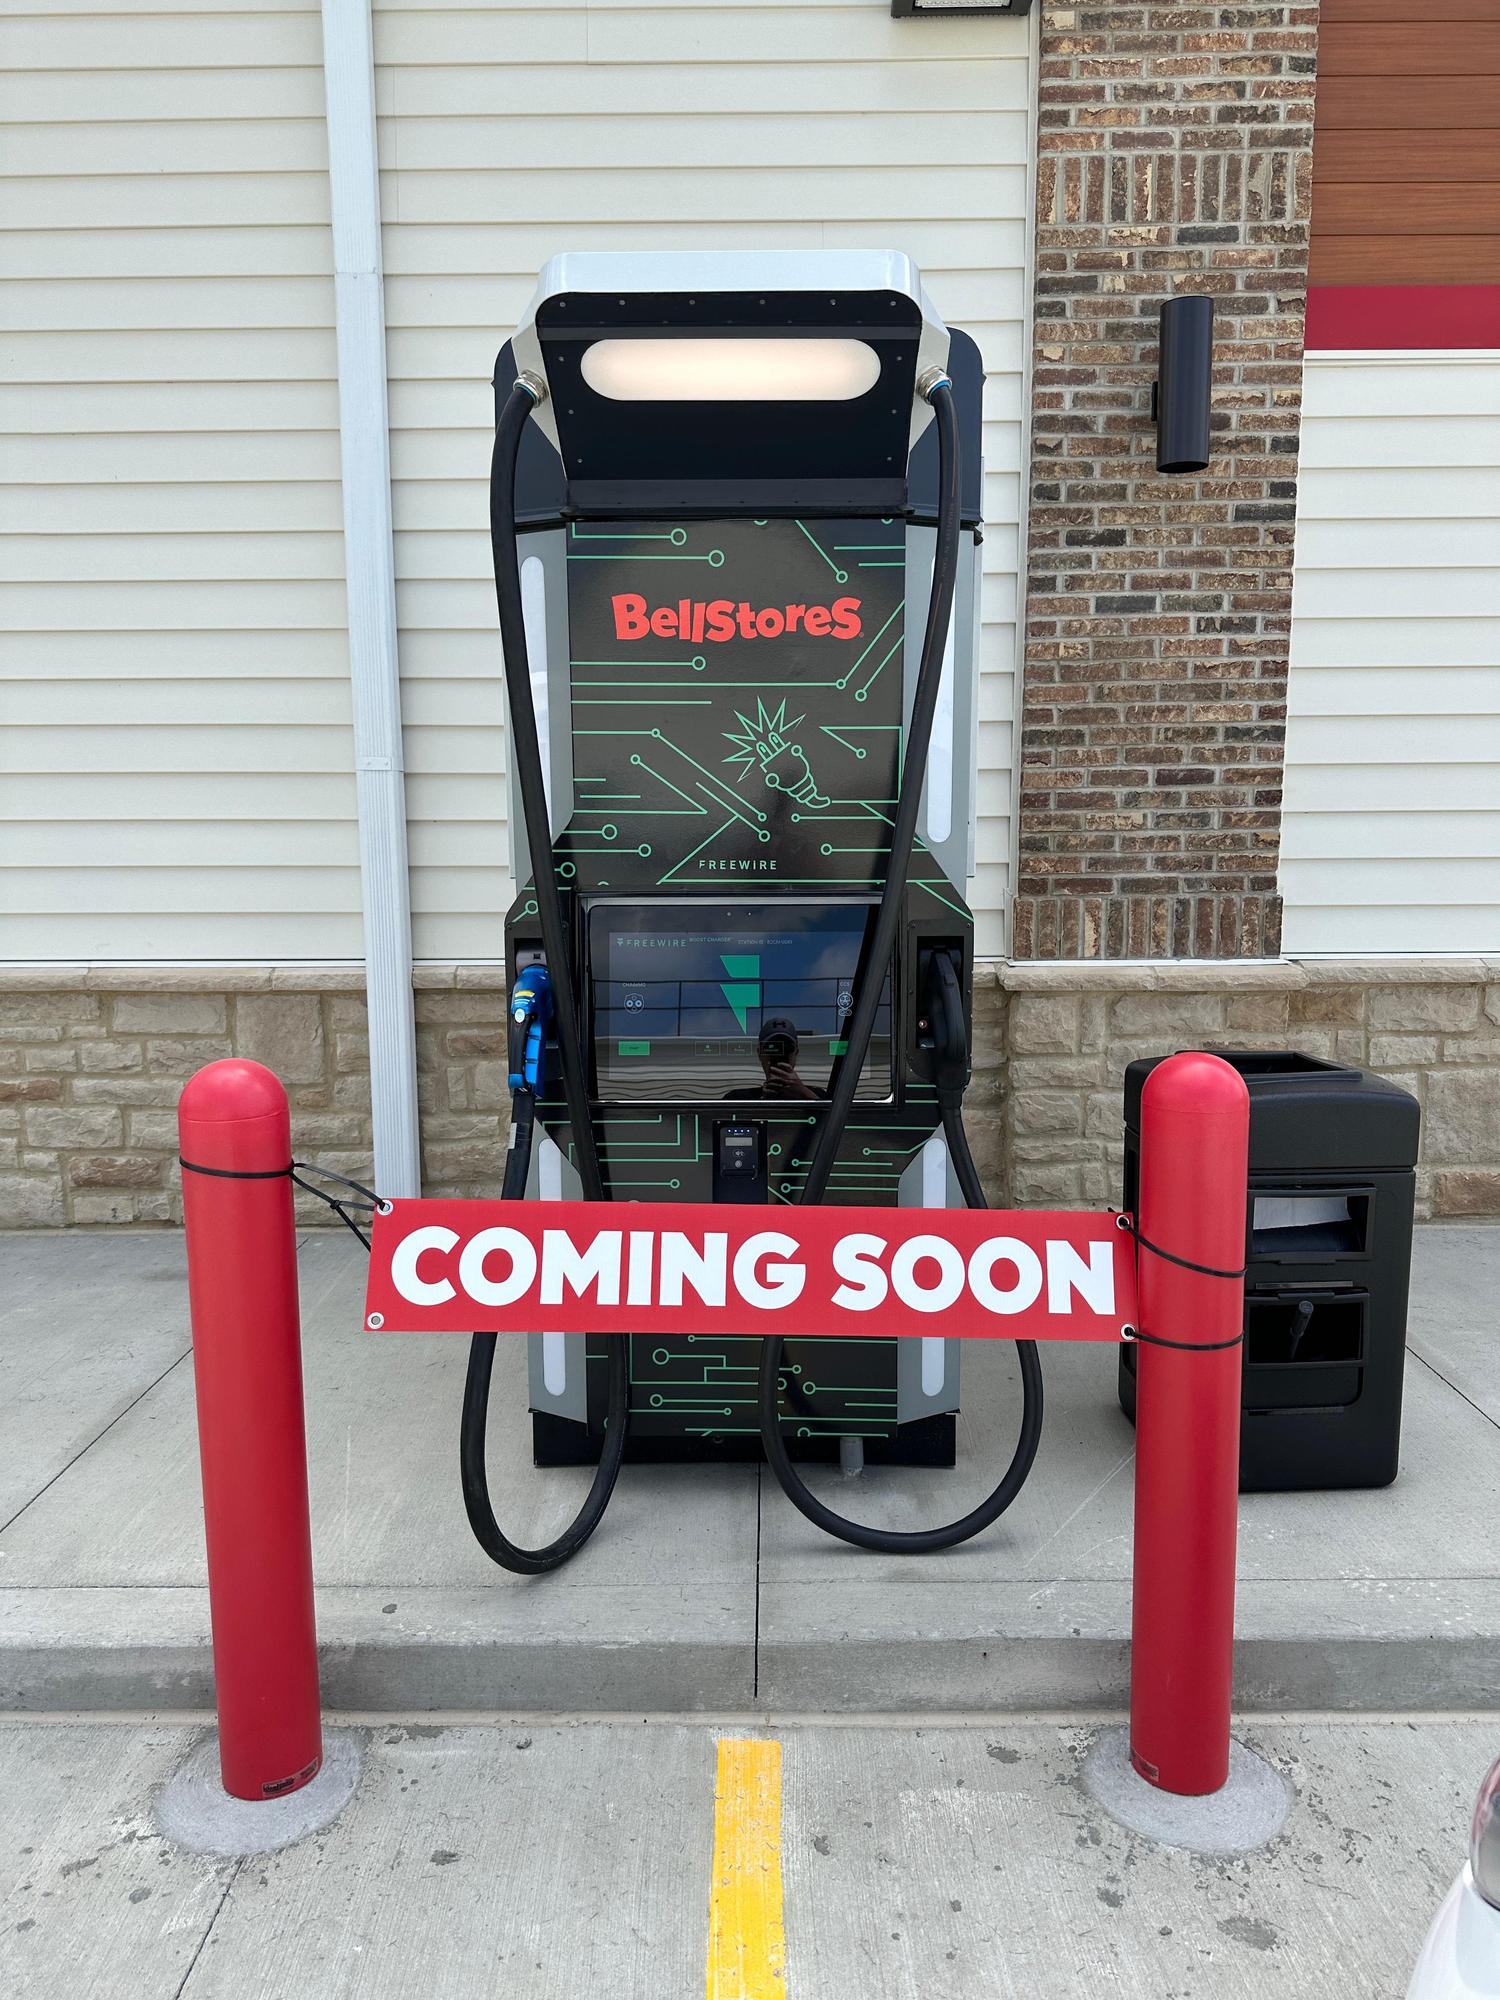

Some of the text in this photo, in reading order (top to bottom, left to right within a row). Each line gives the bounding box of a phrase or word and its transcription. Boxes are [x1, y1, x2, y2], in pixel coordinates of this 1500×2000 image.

[699, 859, 778, 871] FREEWIRE
[627, 938, 687, 948] FREEWIRE
[391, 1225, 1116, 1316] COMING SOON
